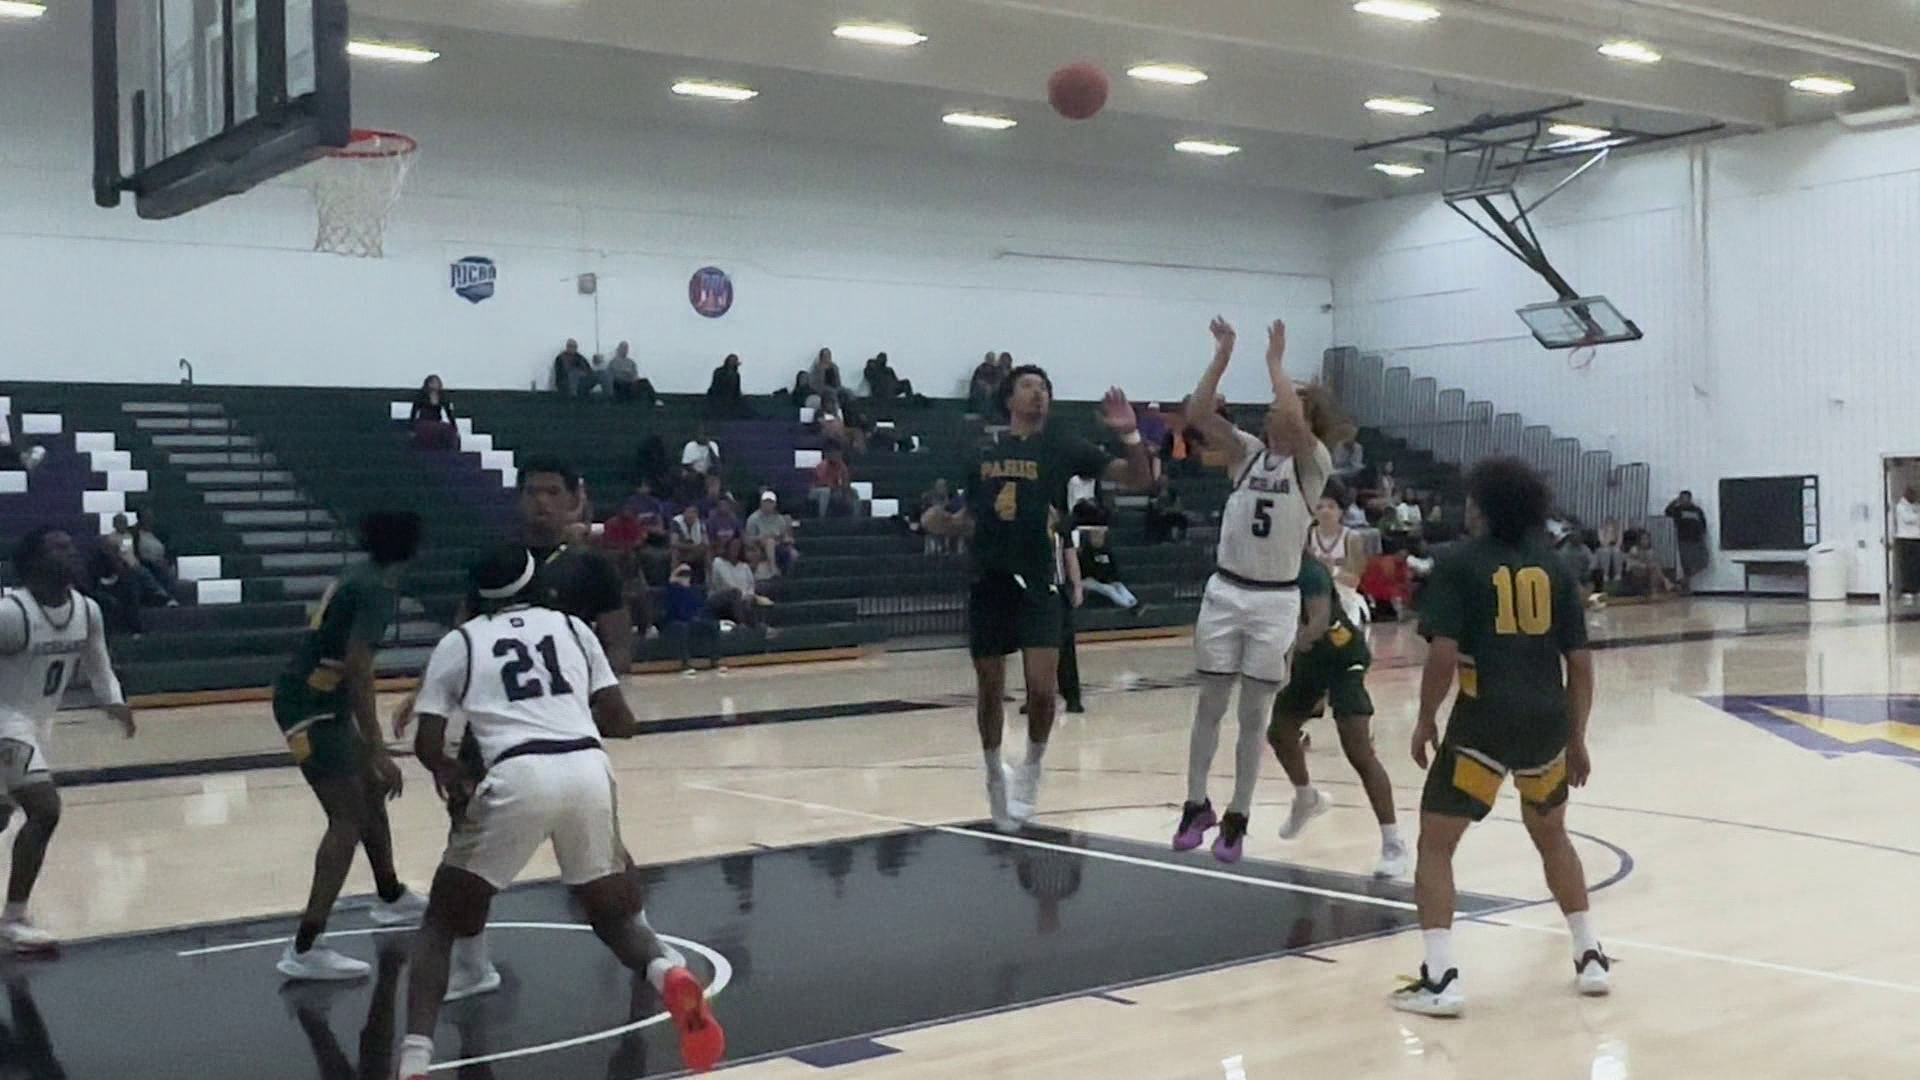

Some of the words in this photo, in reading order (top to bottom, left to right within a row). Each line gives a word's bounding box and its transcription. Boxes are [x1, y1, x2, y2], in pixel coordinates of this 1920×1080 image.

[994, 481, 1017, 521] 4
[1252, 498, 1275, 538] 5
[1492, 565, 1552, 635] 10
[43, 659, 65, 697] 0
[492, 634, 574, 702] 21
